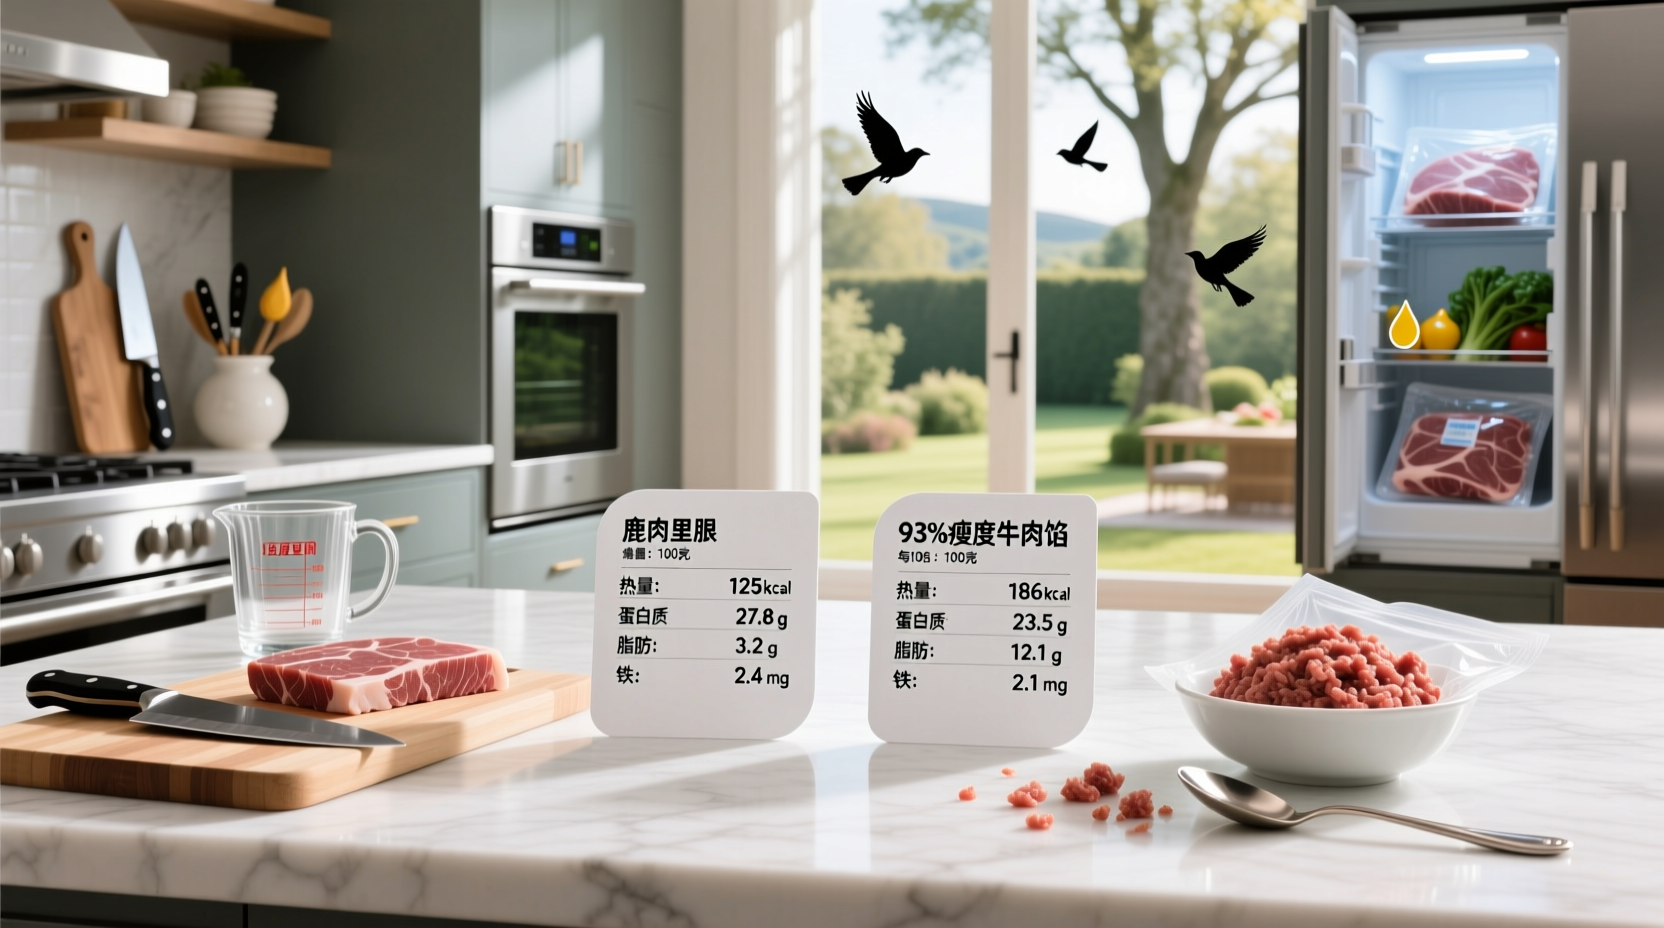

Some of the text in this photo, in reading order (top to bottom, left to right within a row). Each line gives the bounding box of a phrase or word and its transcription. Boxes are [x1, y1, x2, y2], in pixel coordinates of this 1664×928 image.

[898, 519, 1068, 548] 93%瘦度牛肉馅
[619, 575, 660, 596] 热量:
[895, 580, 937, 601] 热量:
[618, 606, 788, 631] 蛋白质 27.8 g
[895, 611, 1068, 637] 蛋白质 23.5 g
[616, 635, 778, 659] 脂肪: 3.2 g
[893, 640, 1062, 667] 脂肪: 12.1 g
[615, 664, 790, 690] 铁: 2.4 mg
[892, 669, 1068, 697] 铁: 2.1 mg
